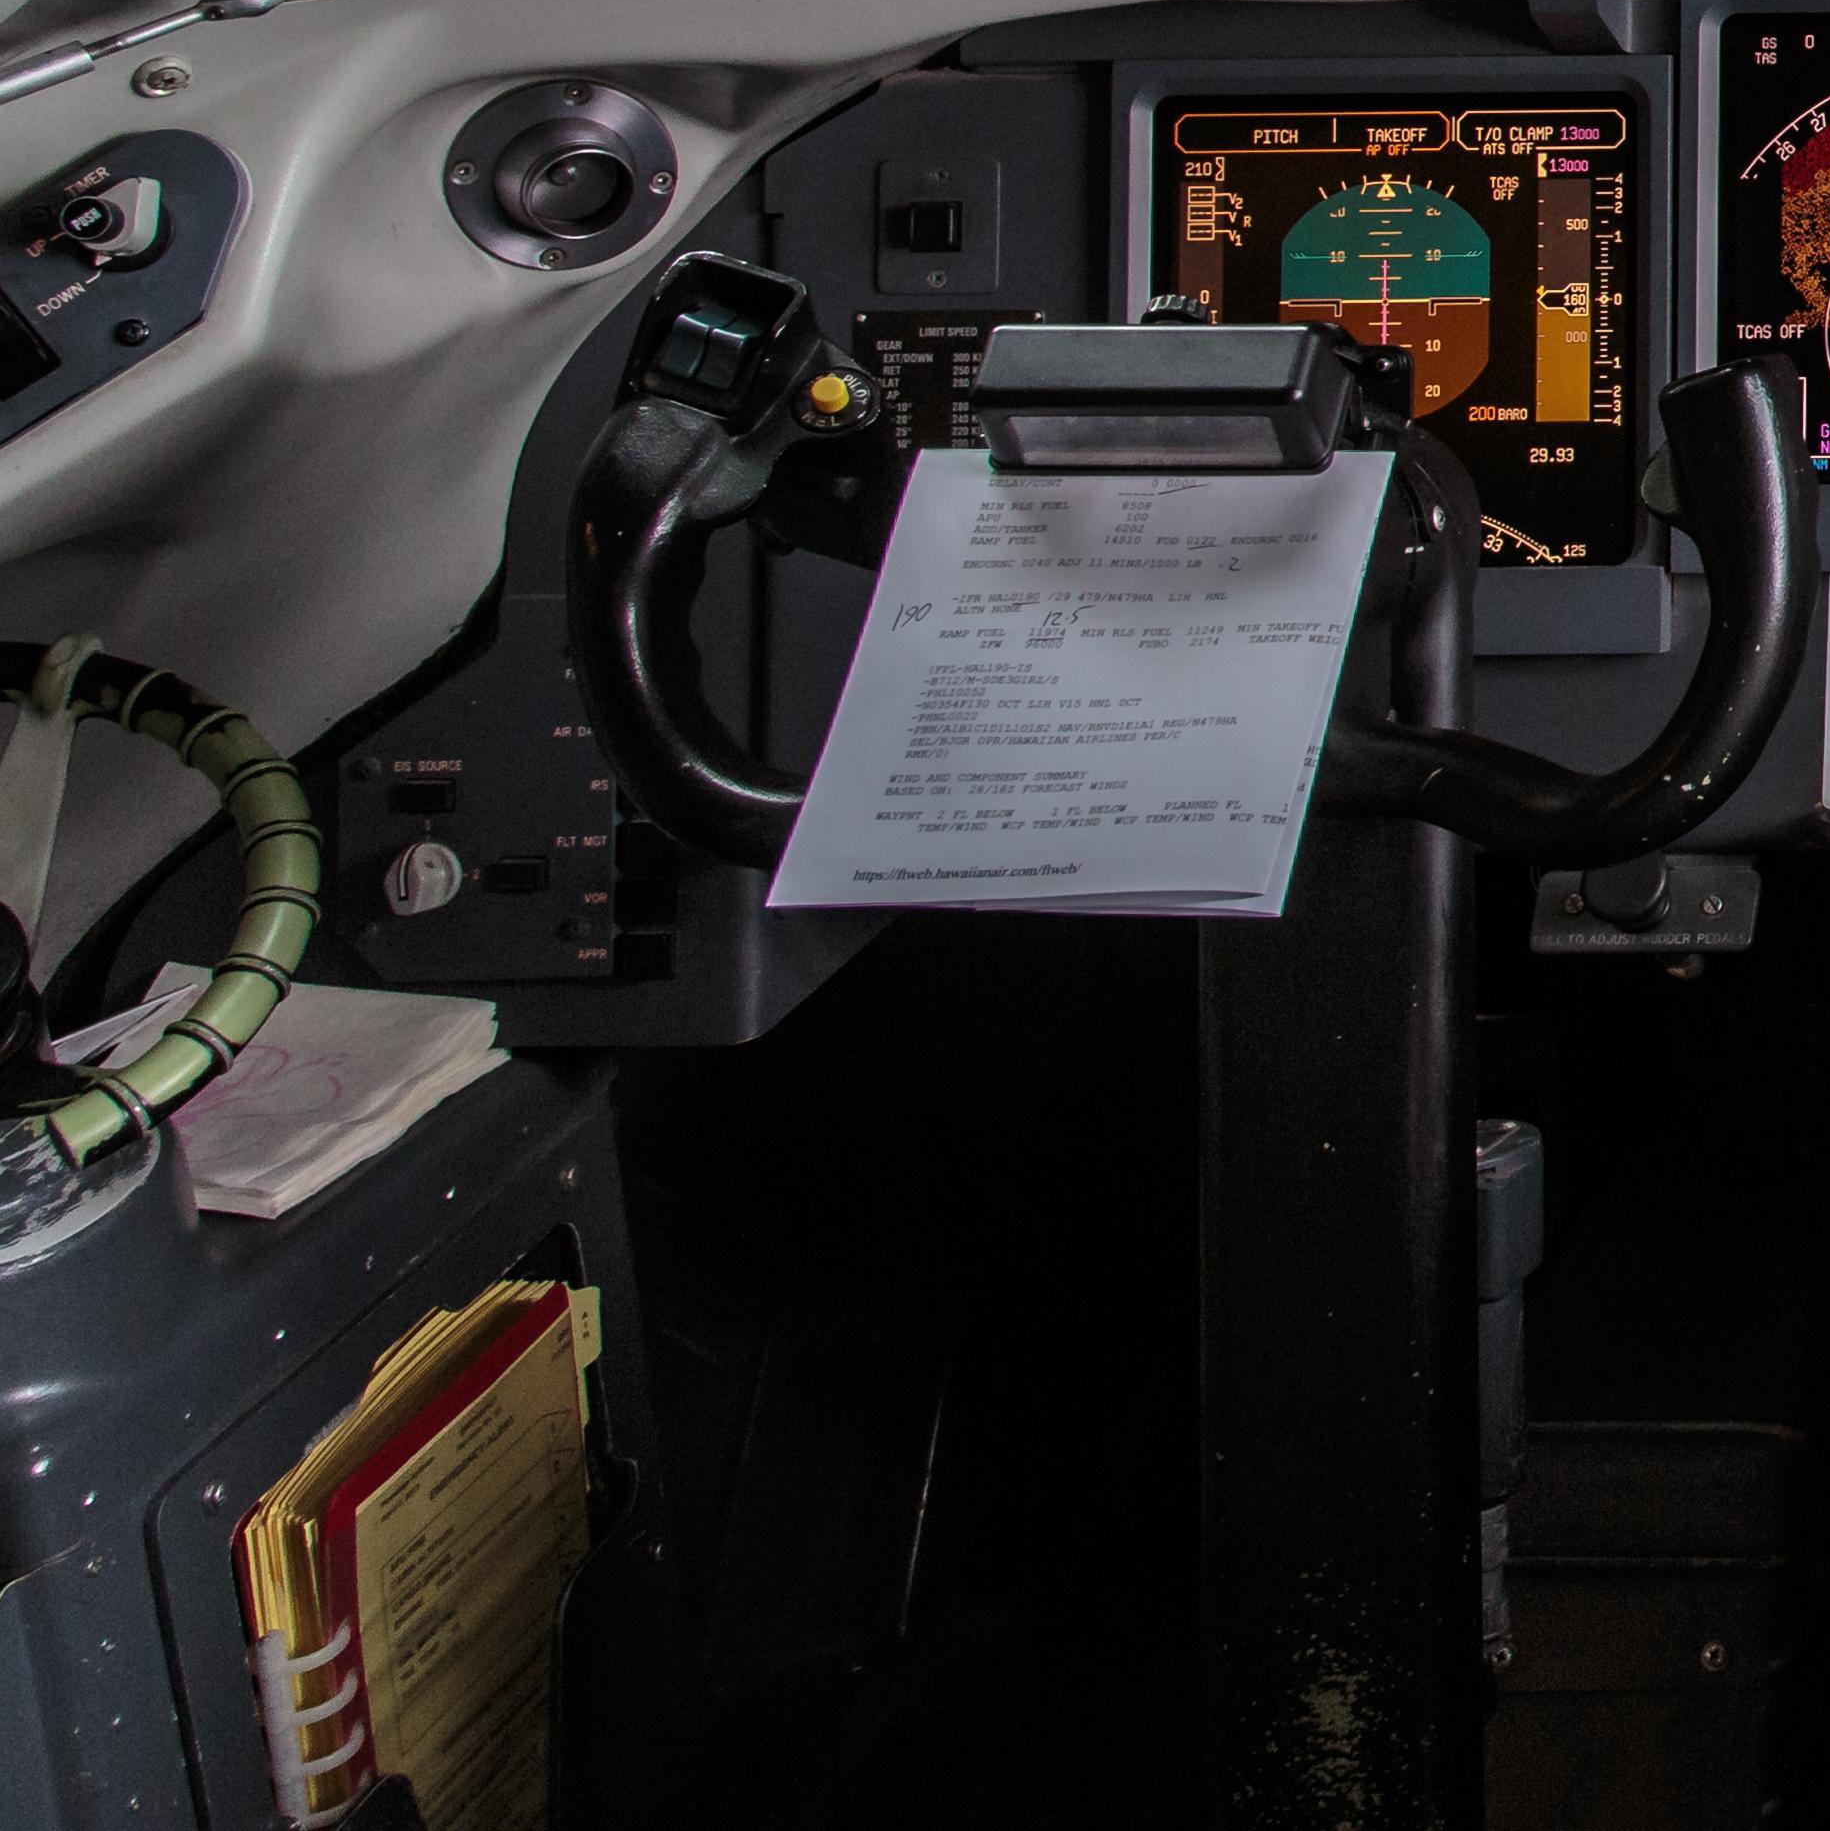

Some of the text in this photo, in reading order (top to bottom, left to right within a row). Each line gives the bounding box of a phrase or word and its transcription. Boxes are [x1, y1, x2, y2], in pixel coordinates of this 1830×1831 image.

[1253, 129, 1299, 144] PITCH
[1366, 127, 1427, 143] TAKEOFF
[1529, 446, 1575, 463] 29.93
